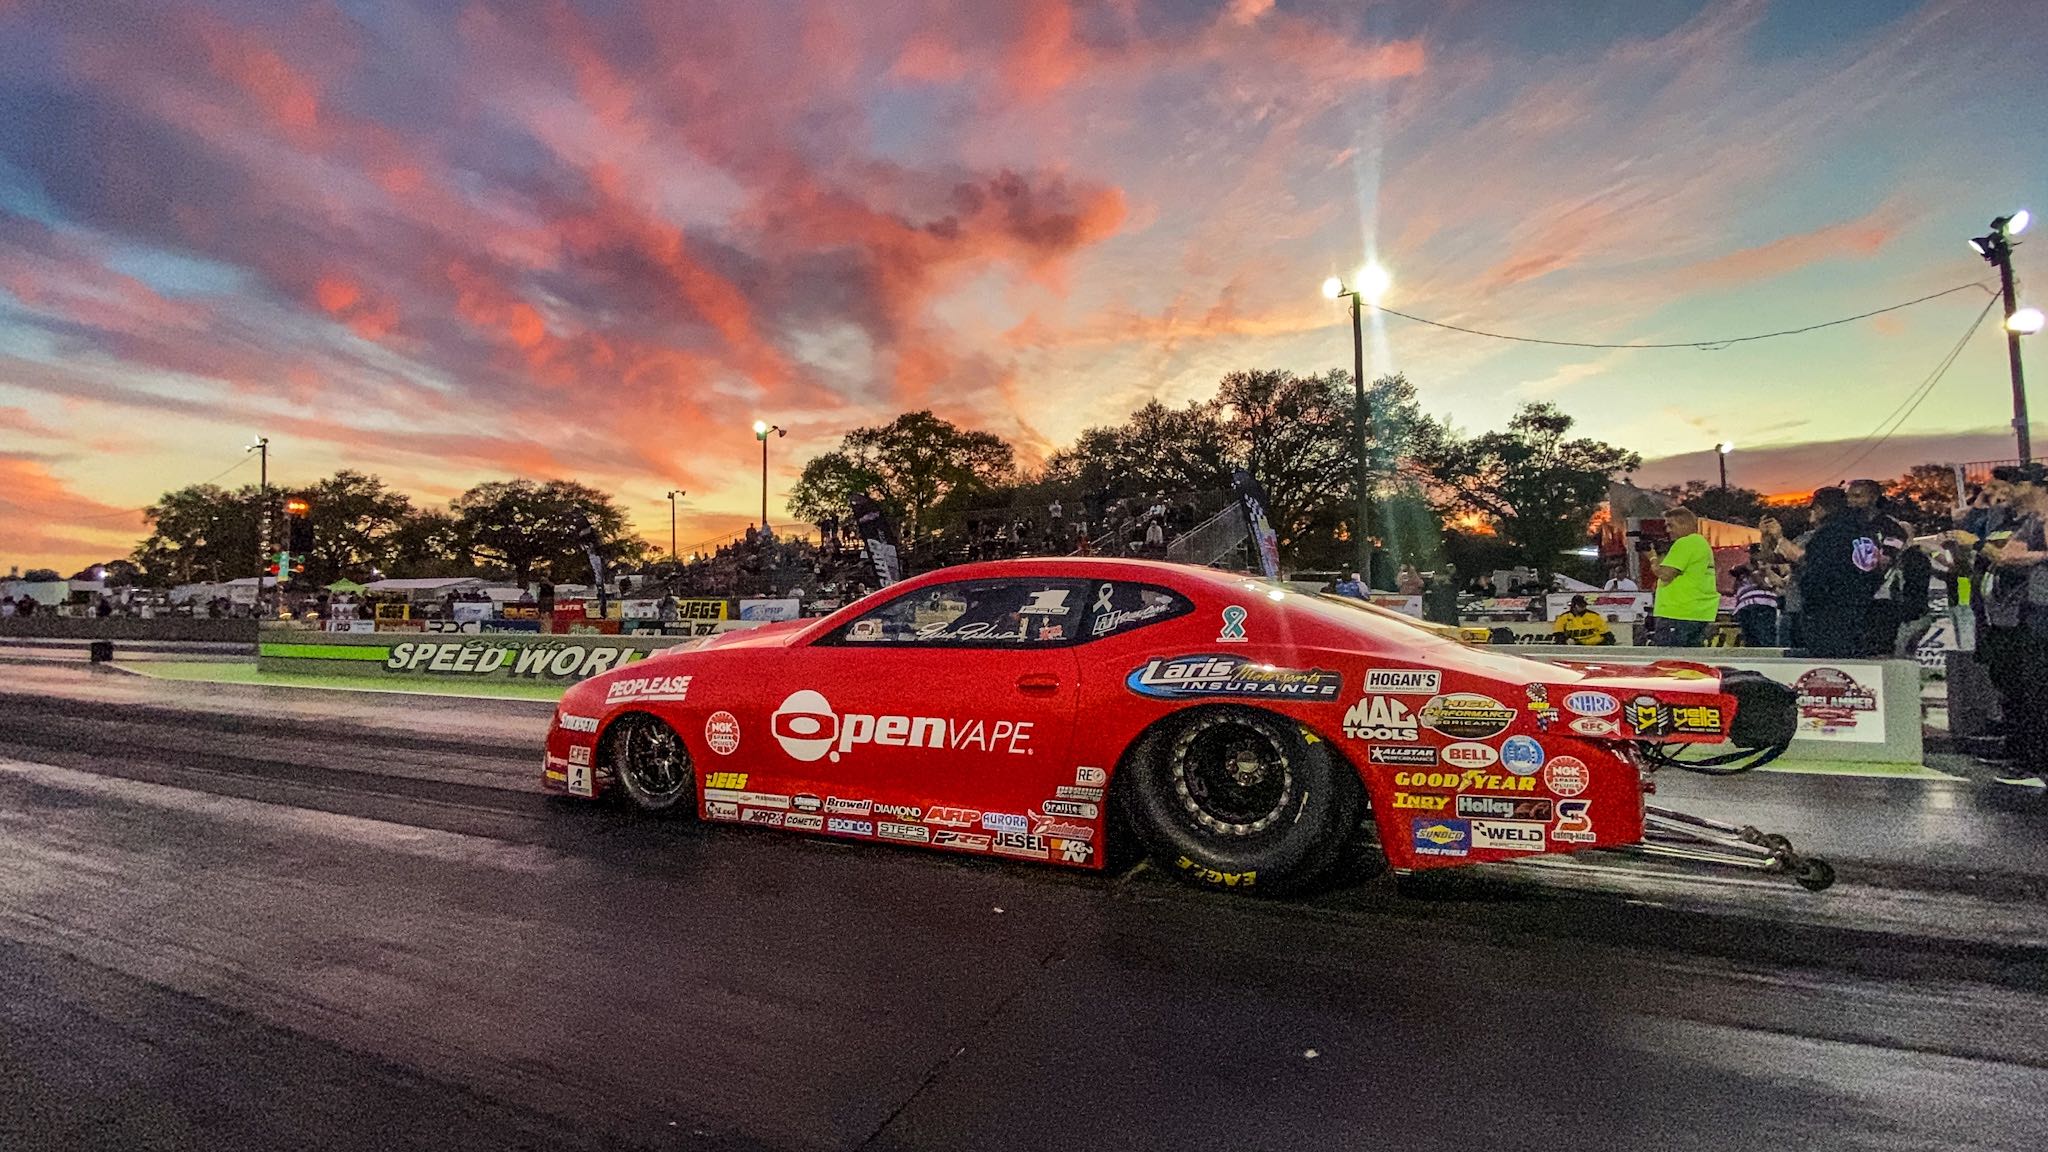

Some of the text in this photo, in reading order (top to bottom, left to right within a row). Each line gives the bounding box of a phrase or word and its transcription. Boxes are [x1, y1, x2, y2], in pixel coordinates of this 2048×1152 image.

[679, 602, 721, 619] JEGS
[388, 643, 668, 677] SPEED WORL
[1141, 658, 1235, 685] Laris
[608, 675, 693, 698] PEOPLEASE
[1370, 673, 1436, 687] HOGAN'S
[1182, 681, 1337, 696] INSURANCE
[1444, 700, 1495, 709] HIGH
[1573, 695, 1612, 712] NHRA
[1796, 695, 1875, 709] ORSLAMMER
[1343, 696, 1417, 729] MAC
[1424, 708, 1513, 719] PERFORMANCE
[711, 722, 733, 733] NGK
[1343, 728, 1419, 741] TOOLS
[1383, 748, 1435, 757] ALLSTAR
[1449, 748, 1492, 761] BELL
[1552, 767, 1580, 777] NGK
[706, 771, 748, 790] JEGS
[828, 797, 871, 810] Browell
[1459, 797, 1514, 818] Holley
[874, 804, 922, 818] DIAMOND
[924, 806, 981, 823] ARP
[787, 816, 822, 828] COMETIC
[984, 814, 1027, 828] AURORA
[1417, 829, 1464, 841] SUNOCO
[1487, 827, 1543, 842] WELD
[994, 833, 1047, 852] JESEL
[1175, 856, 1257, 886] EAGLE
